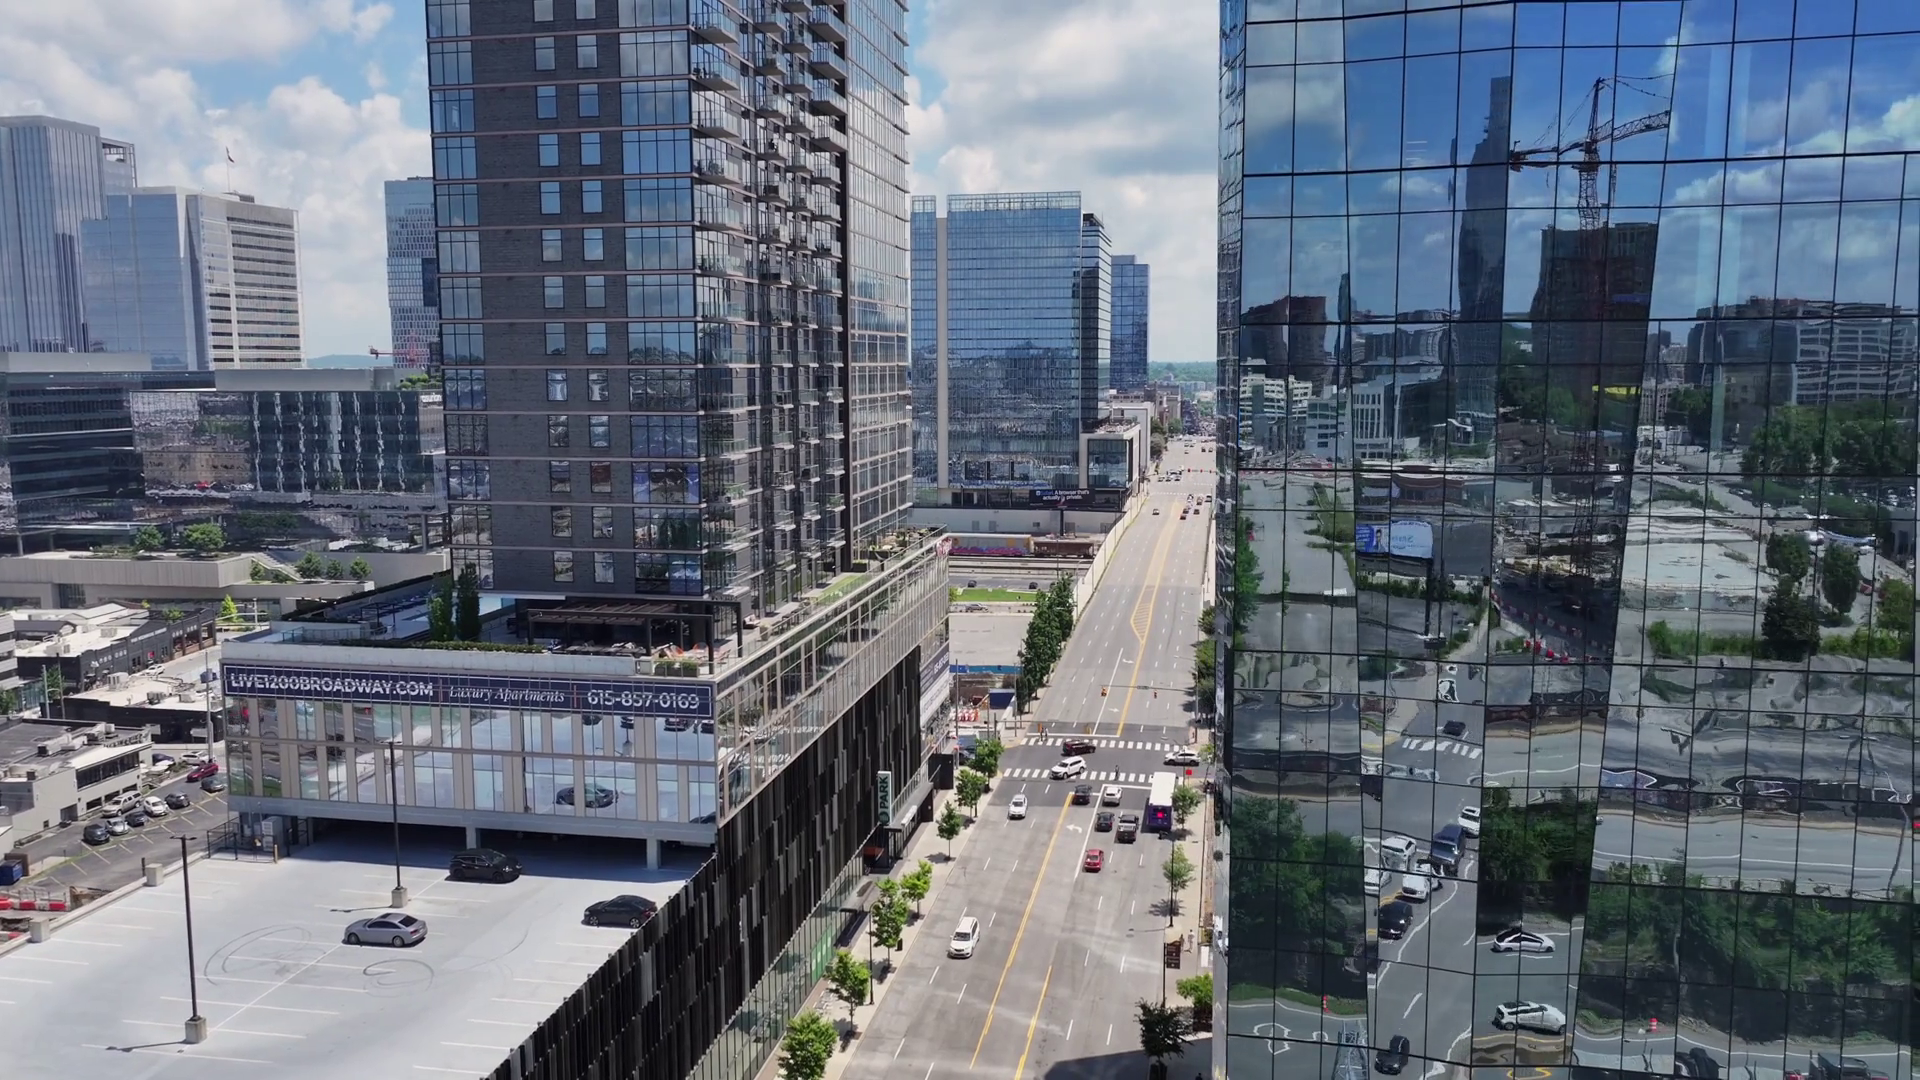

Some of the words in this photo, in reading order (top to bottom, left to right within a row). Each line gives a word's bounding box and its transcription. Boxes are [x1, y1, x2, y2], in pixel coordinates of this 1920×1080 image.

[231, 673, 434, 697] LIVE1200BROADWAY.COM
[449, 686, 493, 702] Luxury
[494, 687, 565, 703] Apartments
[587, 689, 700, 709] 615-857-0169
[879, 776, 889, 809] PARK
